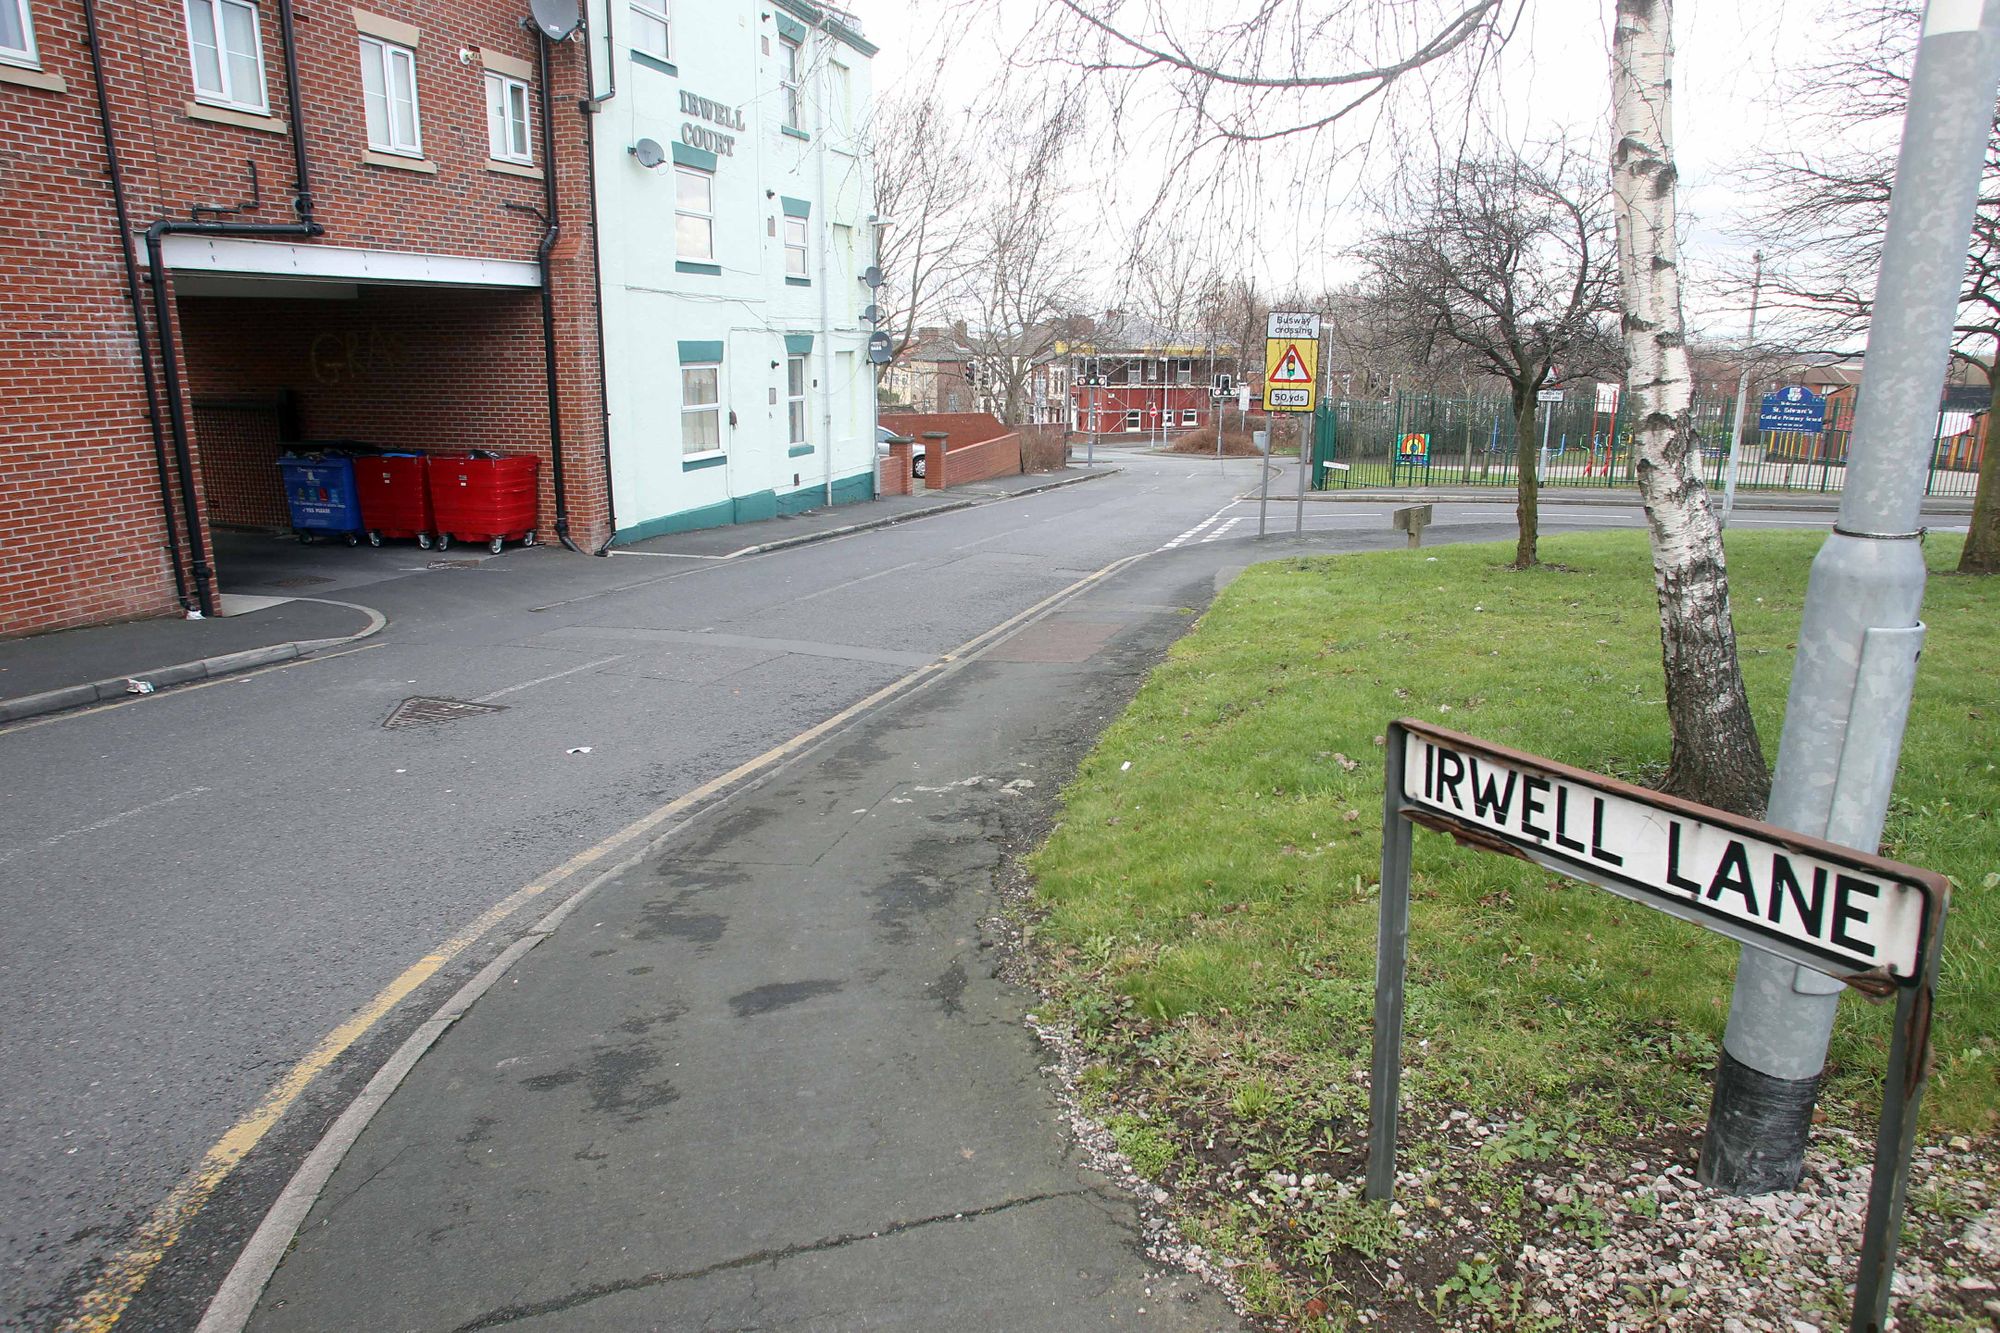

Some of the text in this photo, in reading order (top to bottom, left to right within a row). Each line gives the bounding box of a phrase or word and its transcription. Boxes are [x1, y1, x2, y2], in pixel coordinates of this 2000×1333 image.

[679, 89, 746, 132] IRWELL
[681, 122, 735, 157] COURT
[1274, 327, 1313, 338] crossing
[1276, 316, 1312, 326] Busway
[1274, 393, 1305, 403] 50 yds
[1424, 744, 1880, 958] IRWELL LANE
